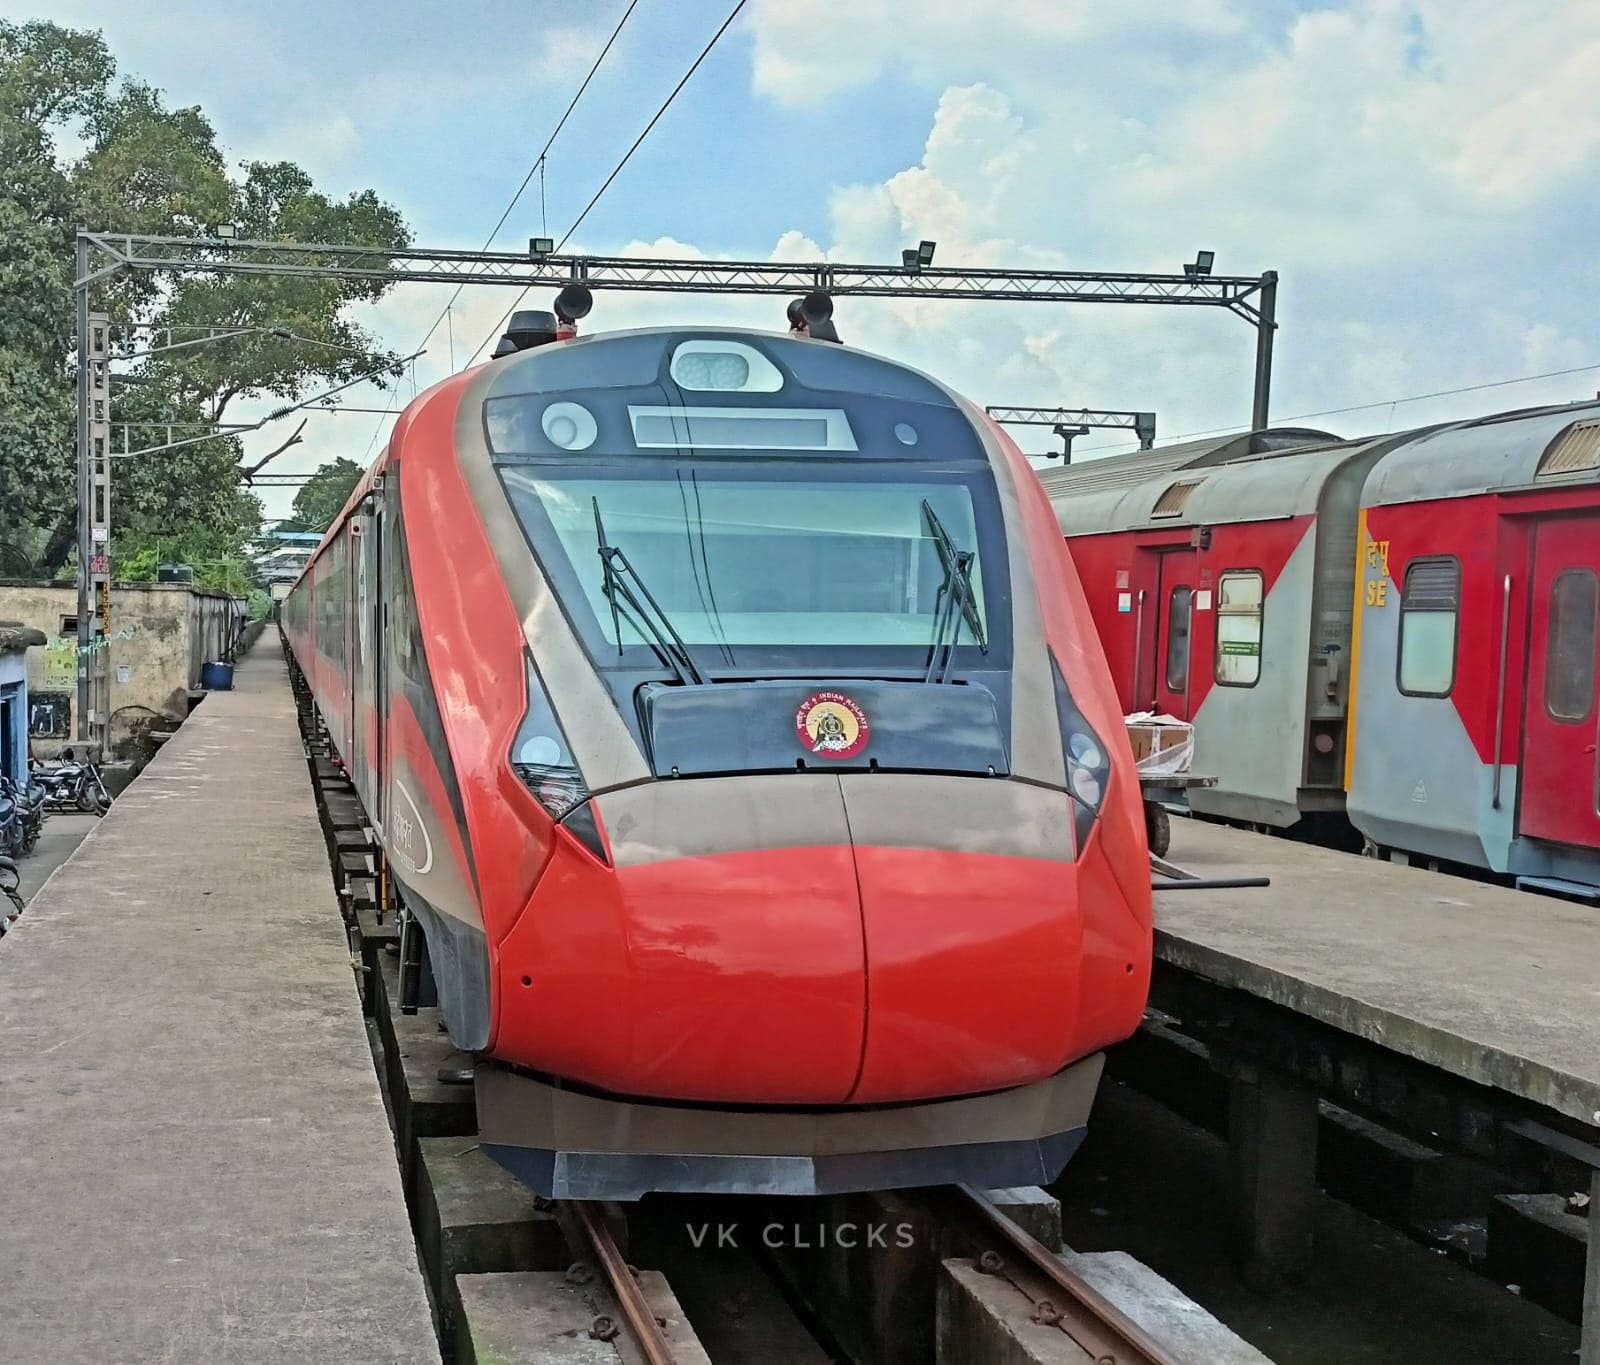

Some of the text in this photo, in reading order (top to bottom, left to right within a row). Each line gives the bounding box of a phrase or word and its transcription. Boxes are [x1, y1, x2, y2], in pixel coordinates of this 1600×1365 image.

[1366, 581, 1388, 607] SE
[818, 692, 868, 729] INDIAN RAILWAYS
